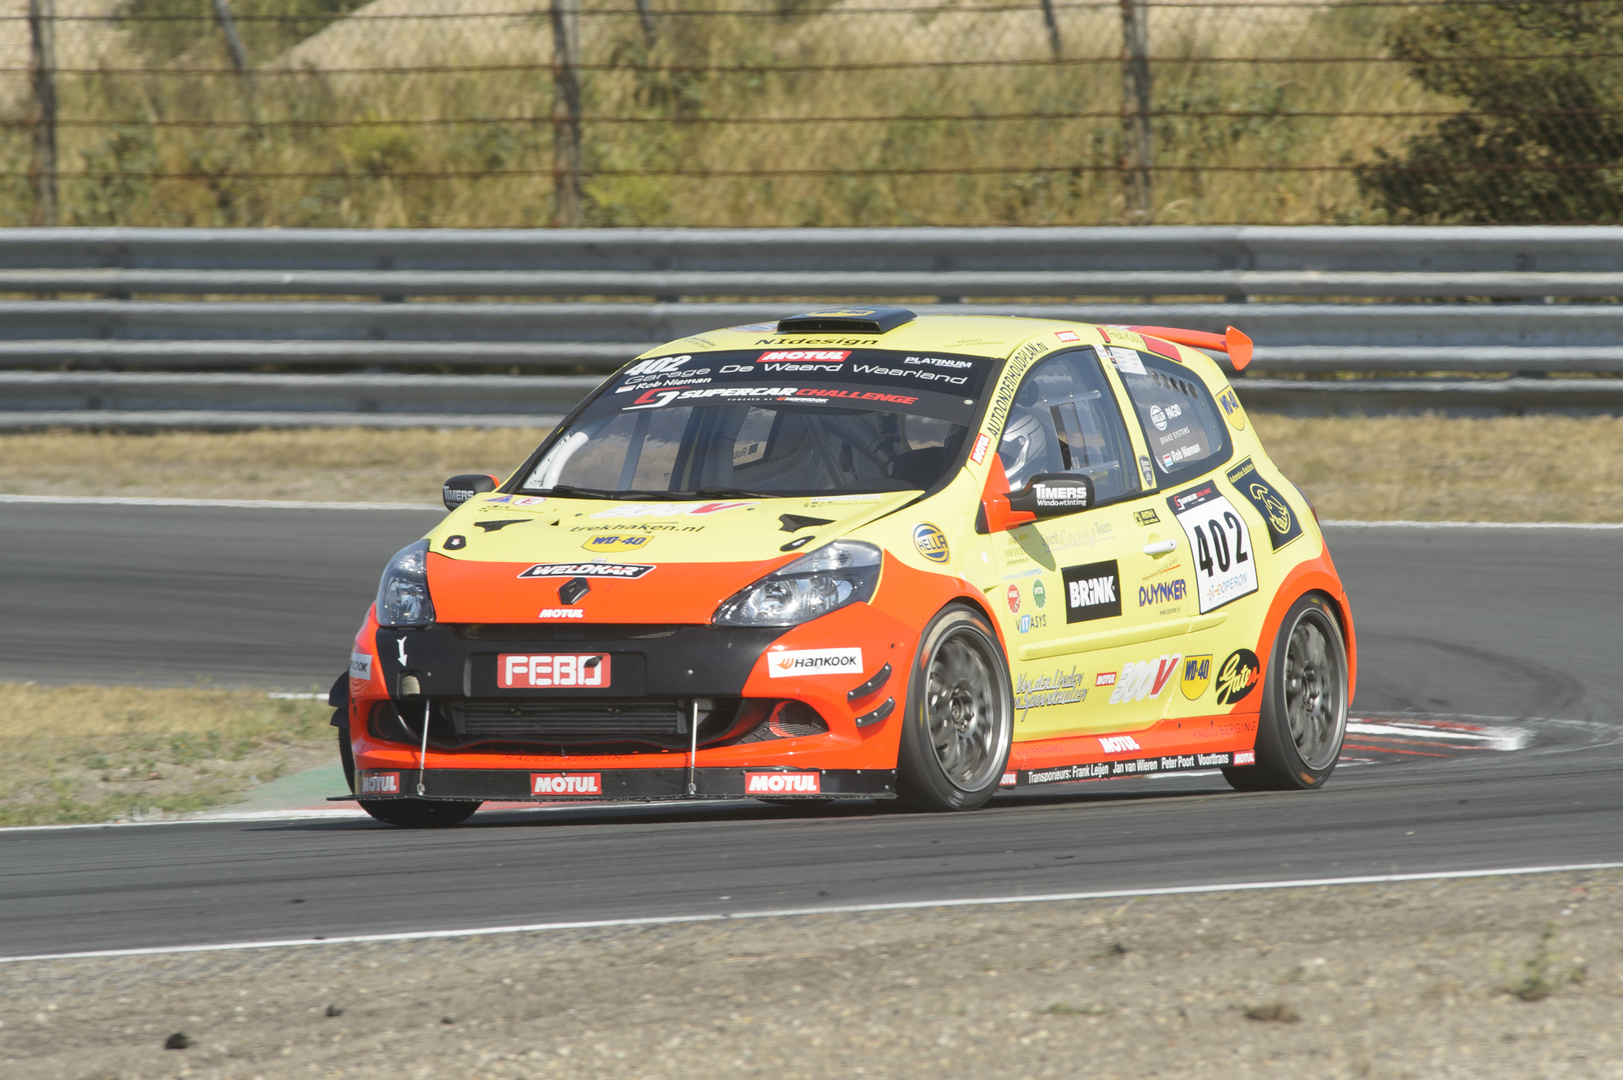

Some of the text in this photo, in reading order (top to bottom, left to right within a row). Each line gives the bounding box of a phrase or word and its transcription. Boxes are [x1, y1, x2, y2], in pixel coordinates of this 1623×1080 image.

[761, 351, 844, 361] MOTUL
[904, 356, 973, 369] PLATINUM
[624, 355, 692, 376] 402
[625, 363, 968, 385] Garage De Waard Waarland
[635, 377, 712, 390] Rob Nieman
[677, 387, 919, 405] SUPERCAR CHALLENGE
[1165, 404, 1181, 419] PAGID
[1159, 426, 1190, 445] BRAKE SYSTEMS
[972, 435, 990, 463] MOTUL
[1171, 443, 1201, 462] Rob Nieman
[1037, 499, 1087, 507] Windowtinting
[570, 524, 706, 534] trekhaken.nl
[592, 536, 648, 545] WD-40
[917, 535, 948, 551] HELLA
[1194, 511, 1248, 578] 402
[532, 565, 640, 576] WELDKAR
[1139, 579, 1187, 608] DUYNKER
[539, 609, 584, 618] MOTUL
[1015, 614, 1047, 633] VITASYS
[505, 656, 602, 686] FEBO
[1184, 659, 1210, 681] WD-40
[1096, 674, 1116, 685] MOTUL
[1216, 653, 1260, 705] Gates
[1220, 720, 1256, 735] BERGING
[1099, 736, 1141, 753] MOTUL
[1072, 765, 1090, 778] Frank
[1113, 761, 1124, 774] Jan
[1125, 762, 1136, 772] van
[1137, 759, 1158, 771] Wieren
[1161, 757, 1177, 769] Peter
[1178, 755, 1194, 768] Poort
[1197, 753, 1229, 766] Voorttrans
[1234, 751, 1255, 764] MOTUL
[362, 776, 397, 792] MOTUL
[534, 777, 598, 792] MOTUL
[749, 776, 817, 791] MOTUL
[1000, 773, 1016, 784] OTUL
